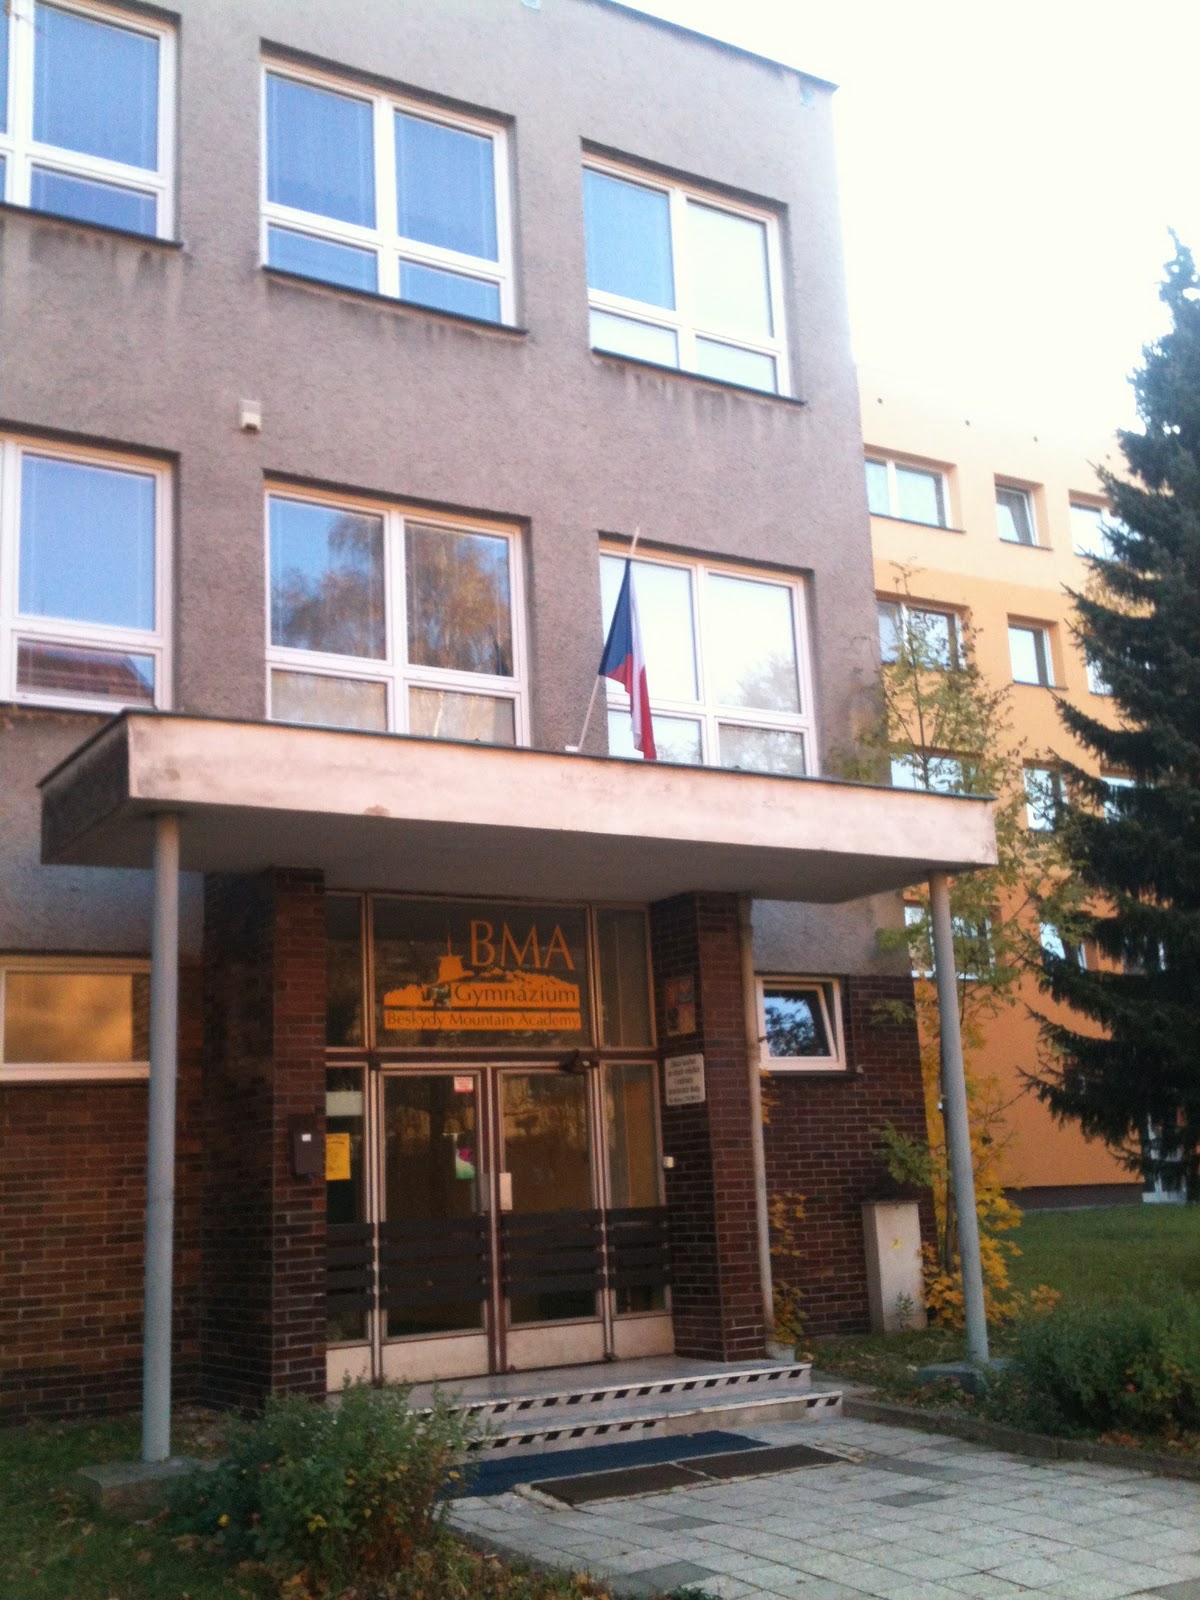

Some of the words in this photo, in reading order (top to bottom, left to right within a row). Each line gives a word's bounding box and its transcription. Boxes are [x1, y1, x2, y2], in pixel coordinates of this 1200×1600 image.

[470, 919, 575, 970] BMA
[454, 984, 577, 1006] Gymnázium
[386, 1012, 445, 1029] Beskydy
[450, 1012, 515, 1026] Mountain
[518, 1012, 579, 1028] Academy
